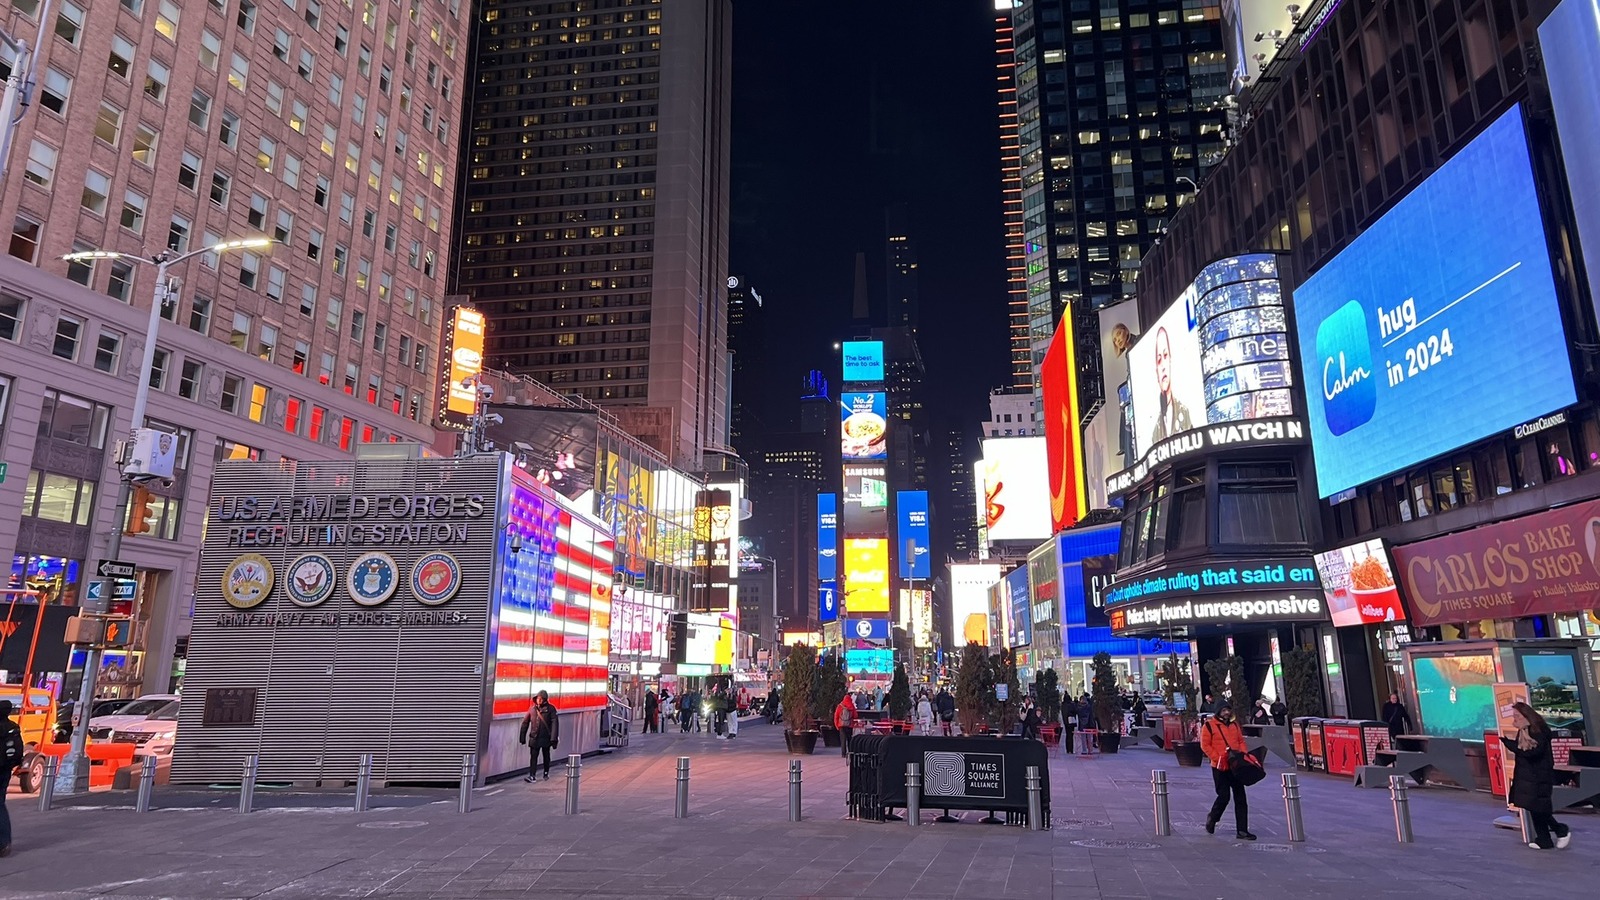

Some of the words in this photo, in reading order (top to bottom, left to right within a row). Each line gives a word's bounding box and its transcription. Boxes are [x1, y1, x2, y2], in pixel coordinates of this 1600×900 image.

[1377, 297, 1418, 339] hug
[1386, 359, 1405, 388] in
[1405, 328, 1454, 378] 2024
[1323, 351, 1371, 401] Calm
[1170, 431, 1204, 458] HULU
[1209, 421, 1283, 445] WATCH
[1288, 421, 1303, 439] N
[845, 467, 885, 476] SAMSUNG
[218, 496, 262, 520] U.S.
[268, 495, 370, 520] ARMED
[373, 494, 485, 519] FORCES
[910, 515, 926, 523] VISA
[821, 517, 836, 525] VISA
[227, 524, 365, 547] RECRUITING
[370, 523, 468, 543] STATION
[1523, 524, 1575, 554] BAKE
[103, 564, 115, 573] ONE
[119, 566, 131, 574] WAY
[1143, 576, 1167, 595] climate
[1167, 572, 1200, 593] ruling
[1201, 567, 1238, 587] that
[1241, 565, 1285, 584] said
[1289, 567, 1314, 582] en
[1407, 537, 1529, 618] CARLO'S
[1531, 551, 1583, 587] SHOP
[1542, 583, 1567, 597] Buddy
[1567, 580, 1600, 593] Valastro
[1161, 600, 1193, 621] found
[1194, 595, 1320, 620] unresponsive
[1443, 594, 1473, 612] TIMES
[1475, 591, 1515, 609] SQUARE
[216, 613, 253, 625] ARMY
[264, 613, 304, 625] NAVY
[320, 612, 341, 625] AIR
[350, 612, 393, 625] FORCE
[405, 611, 461, 624] MARINES
[608, 663, 631, 672] ECHERS
[968, 772, 1000, 781] SQUARE
[970, 762, 997, 771] TIMES
